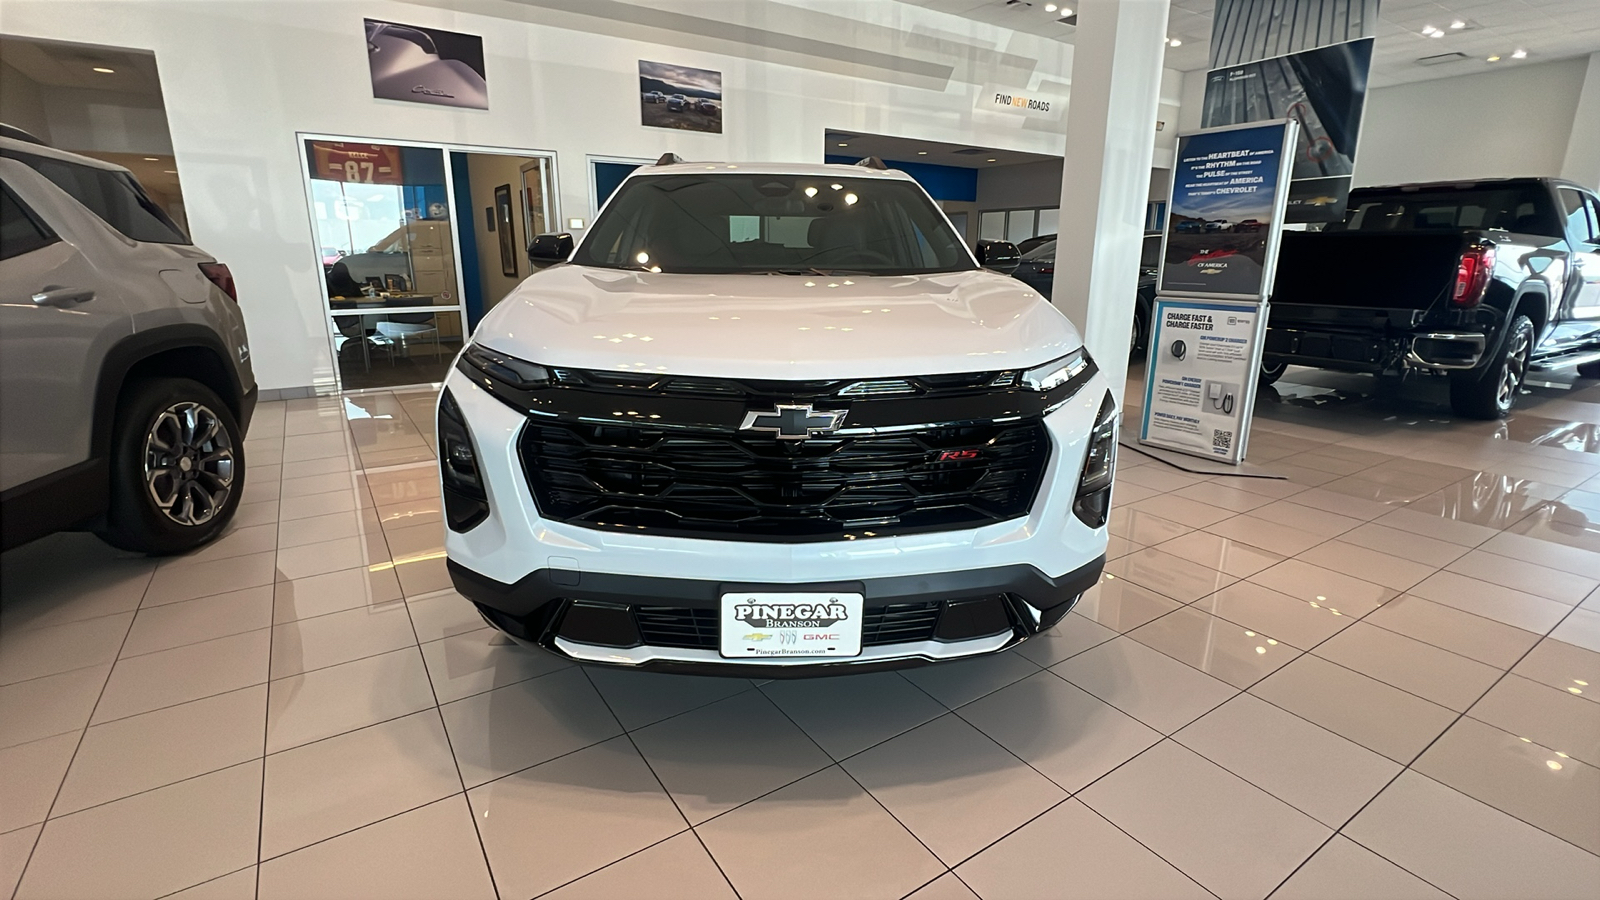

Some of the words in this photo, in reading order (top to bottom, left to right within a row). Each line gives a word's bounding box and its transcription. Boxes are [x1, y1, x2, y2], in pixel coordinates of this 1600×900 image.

[994, 93, 1012, 106] FIND
[1012, 96, 1028, 108] NEW
[1028, 99, 1050, 112] ROADS
[1208, 149, 1250, 160] HEARTBEAT
[1205, 160, 1236, 169] RHYTHM
[345, 160, 374, 184] 87
[1203, 170, 1225, 178] PULSE
[1229, 176, 1263, 185] AMERICA
[1216, 186, 1257, 195] CHEVROLET
[1167, 313, 1190, 321] CHARGE
[1191, 314, 1207, 323] FAST
[1207, 315, 1213, 323] &
[1166, 320, 1190, 329] CHARGE
[1190, 322, 1213, 331] FASTER
[940, 449, 980, 460] RS
[734, 604, 848, 621] PINEGAR
[766, 619, 820, 628] BRANSON
[755, 649, 826, 657] PinegarBranson.com
